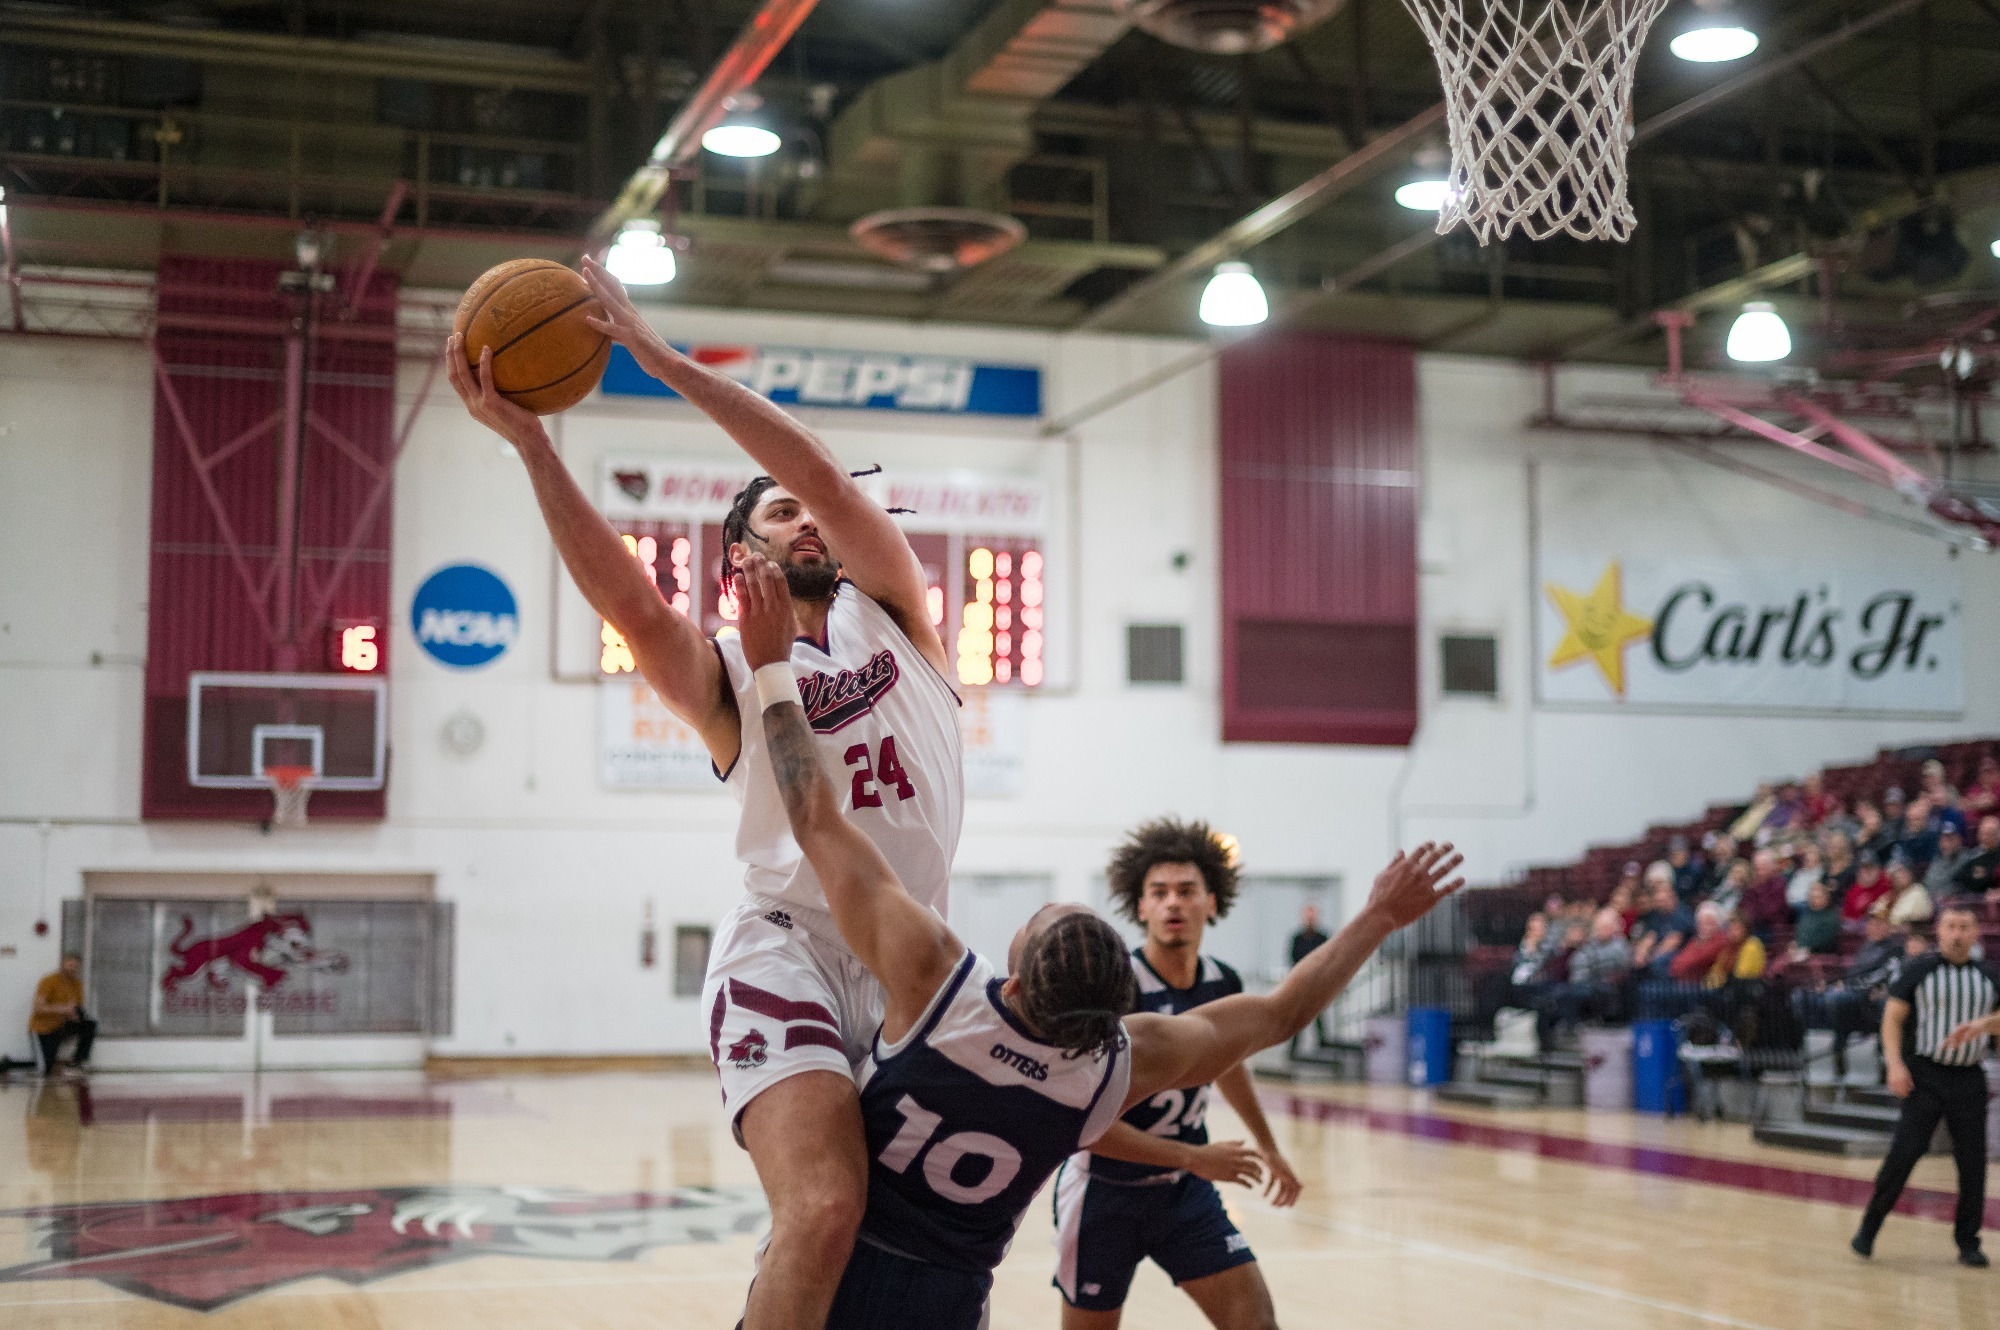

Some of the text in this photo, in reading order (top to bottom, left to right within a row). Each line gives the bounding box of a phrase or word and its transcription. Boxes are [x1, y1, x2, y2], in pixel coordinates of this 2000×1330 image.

[757, 352, 972, 408] PEPSI
[418, 608, 517, 648] NCAA
[1650, 581, 1944, 681] Carl's Jr.
[844, 736, 915, 810] 24
[765, 914, 794, 930] adidas
[989, 1043, 1050, 1082] OTTERS
[1147, 1083, 1209, 1136] 24
[878, 1093, 1022, 1206] 10
